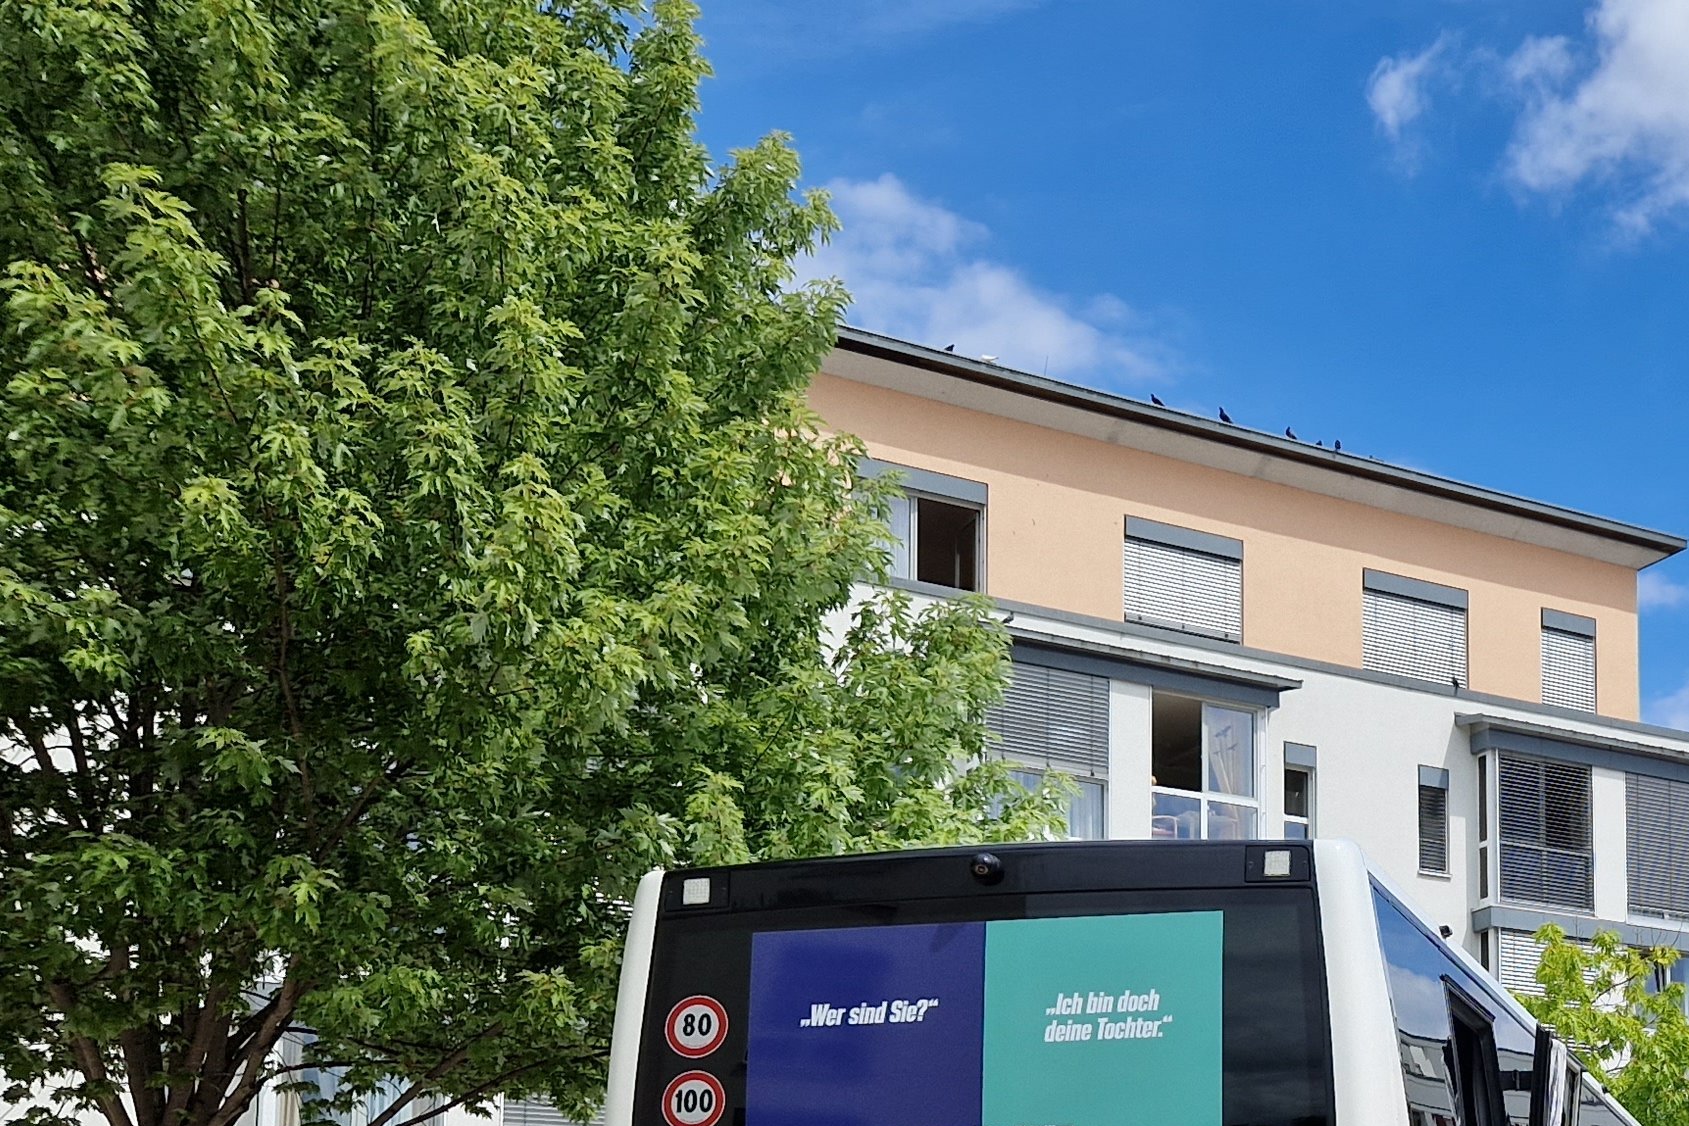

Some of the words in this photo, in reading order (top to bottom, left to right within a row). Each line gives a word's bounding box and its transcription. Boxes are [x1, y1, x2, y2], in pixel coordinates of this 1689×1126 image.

[800, 1004, 843, 1027] „Wer
[848, 1002, 885, 1025] sind
[888, 999, 939, 1023] Sie?“
[1045, 992, 1082, 1016] „Ich
[1086, 991, 1114, 1014] bin
[1117, 989, 1160, 1012] doch
[683, 1013, 712, 1037] 80
[1044, 1020, 1092, 1042] deine
[1097, 1014, 1173, 1040] Tochter.“
[675, 1089, 713, 1113] 100
